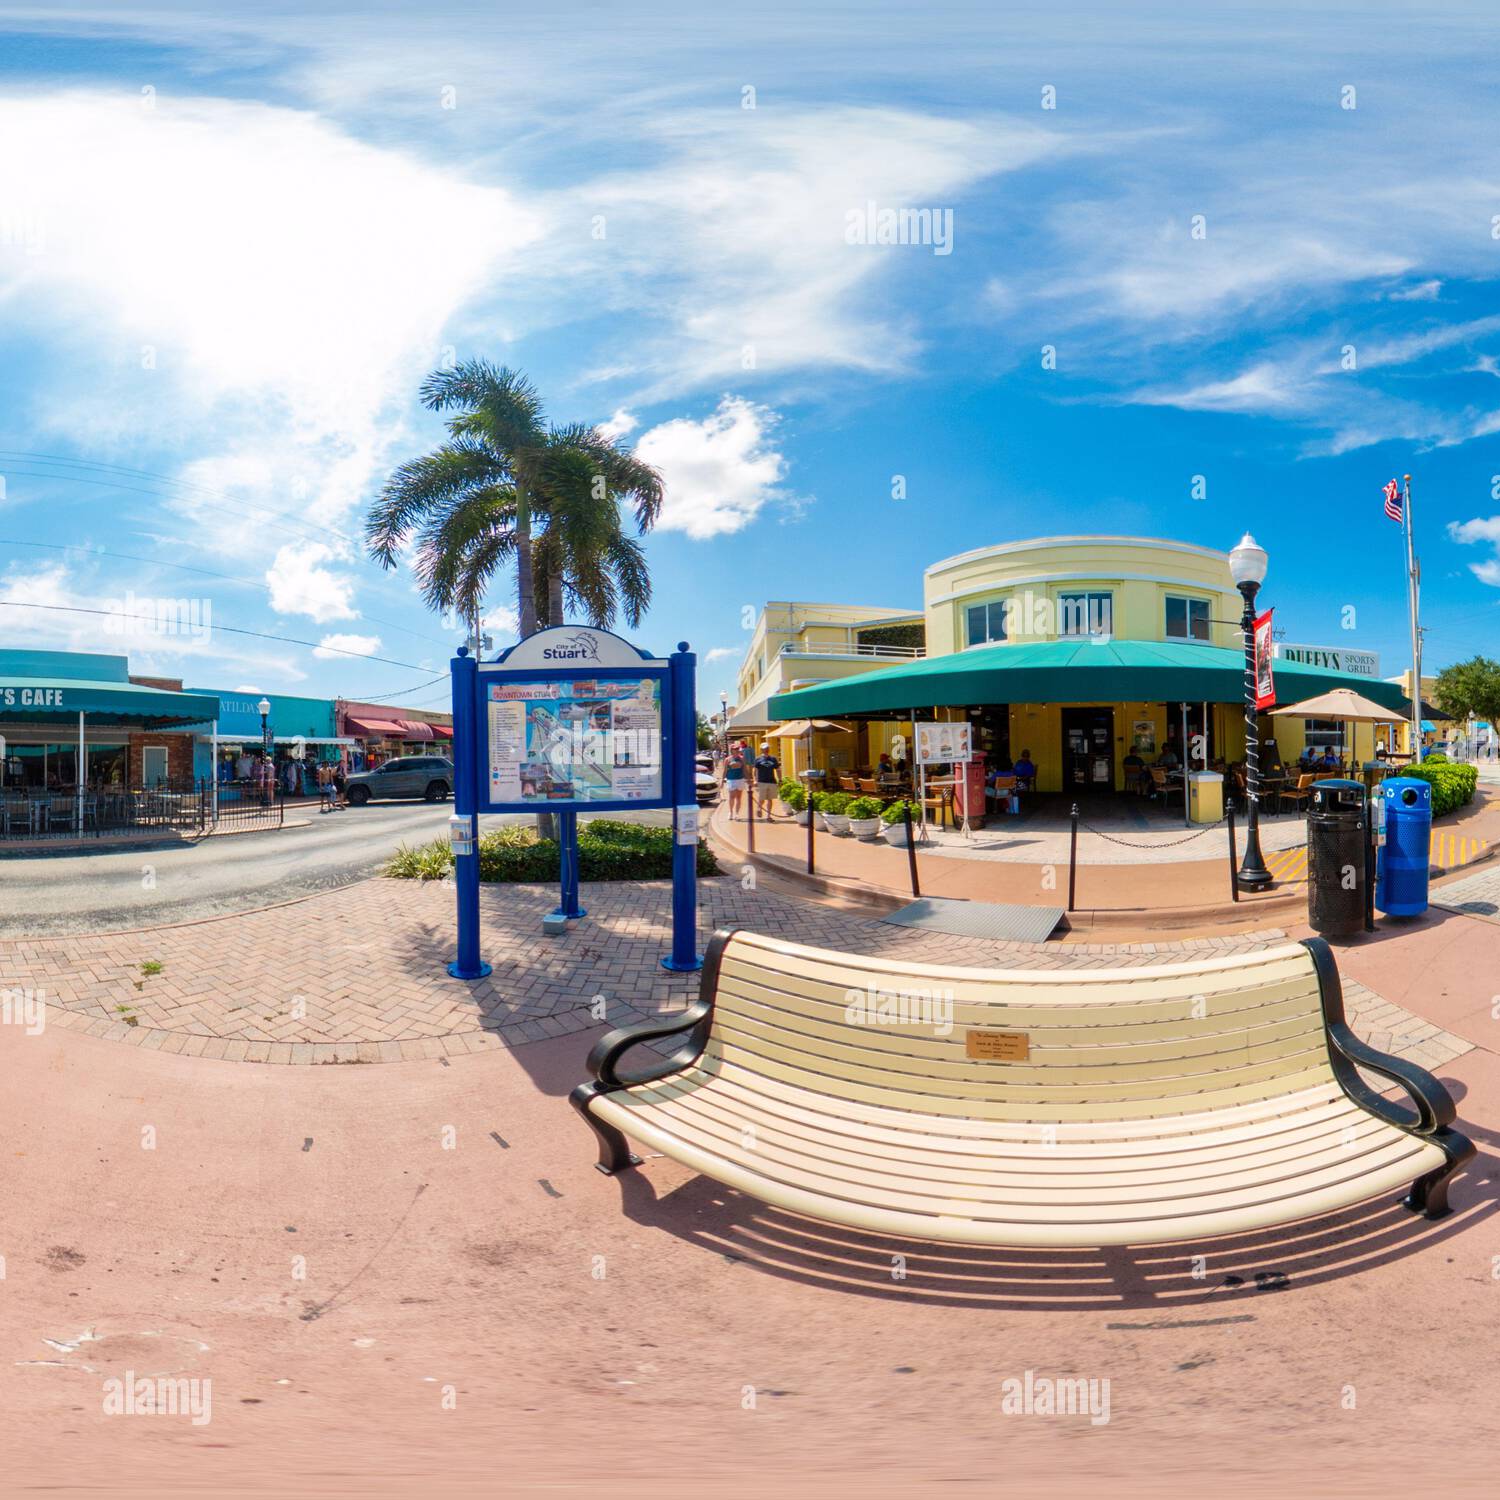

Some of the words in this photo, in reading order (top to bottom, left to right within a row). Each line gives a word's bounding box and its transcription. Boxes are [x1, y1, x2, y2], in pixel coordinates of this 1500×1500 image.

[543, 648, 587, 660] Stuart
[1344, 654, 1376, 665] SPORTS
[1347, 665, 1373, 675] GRILL
[21, 688, 64, 706] CAFE
